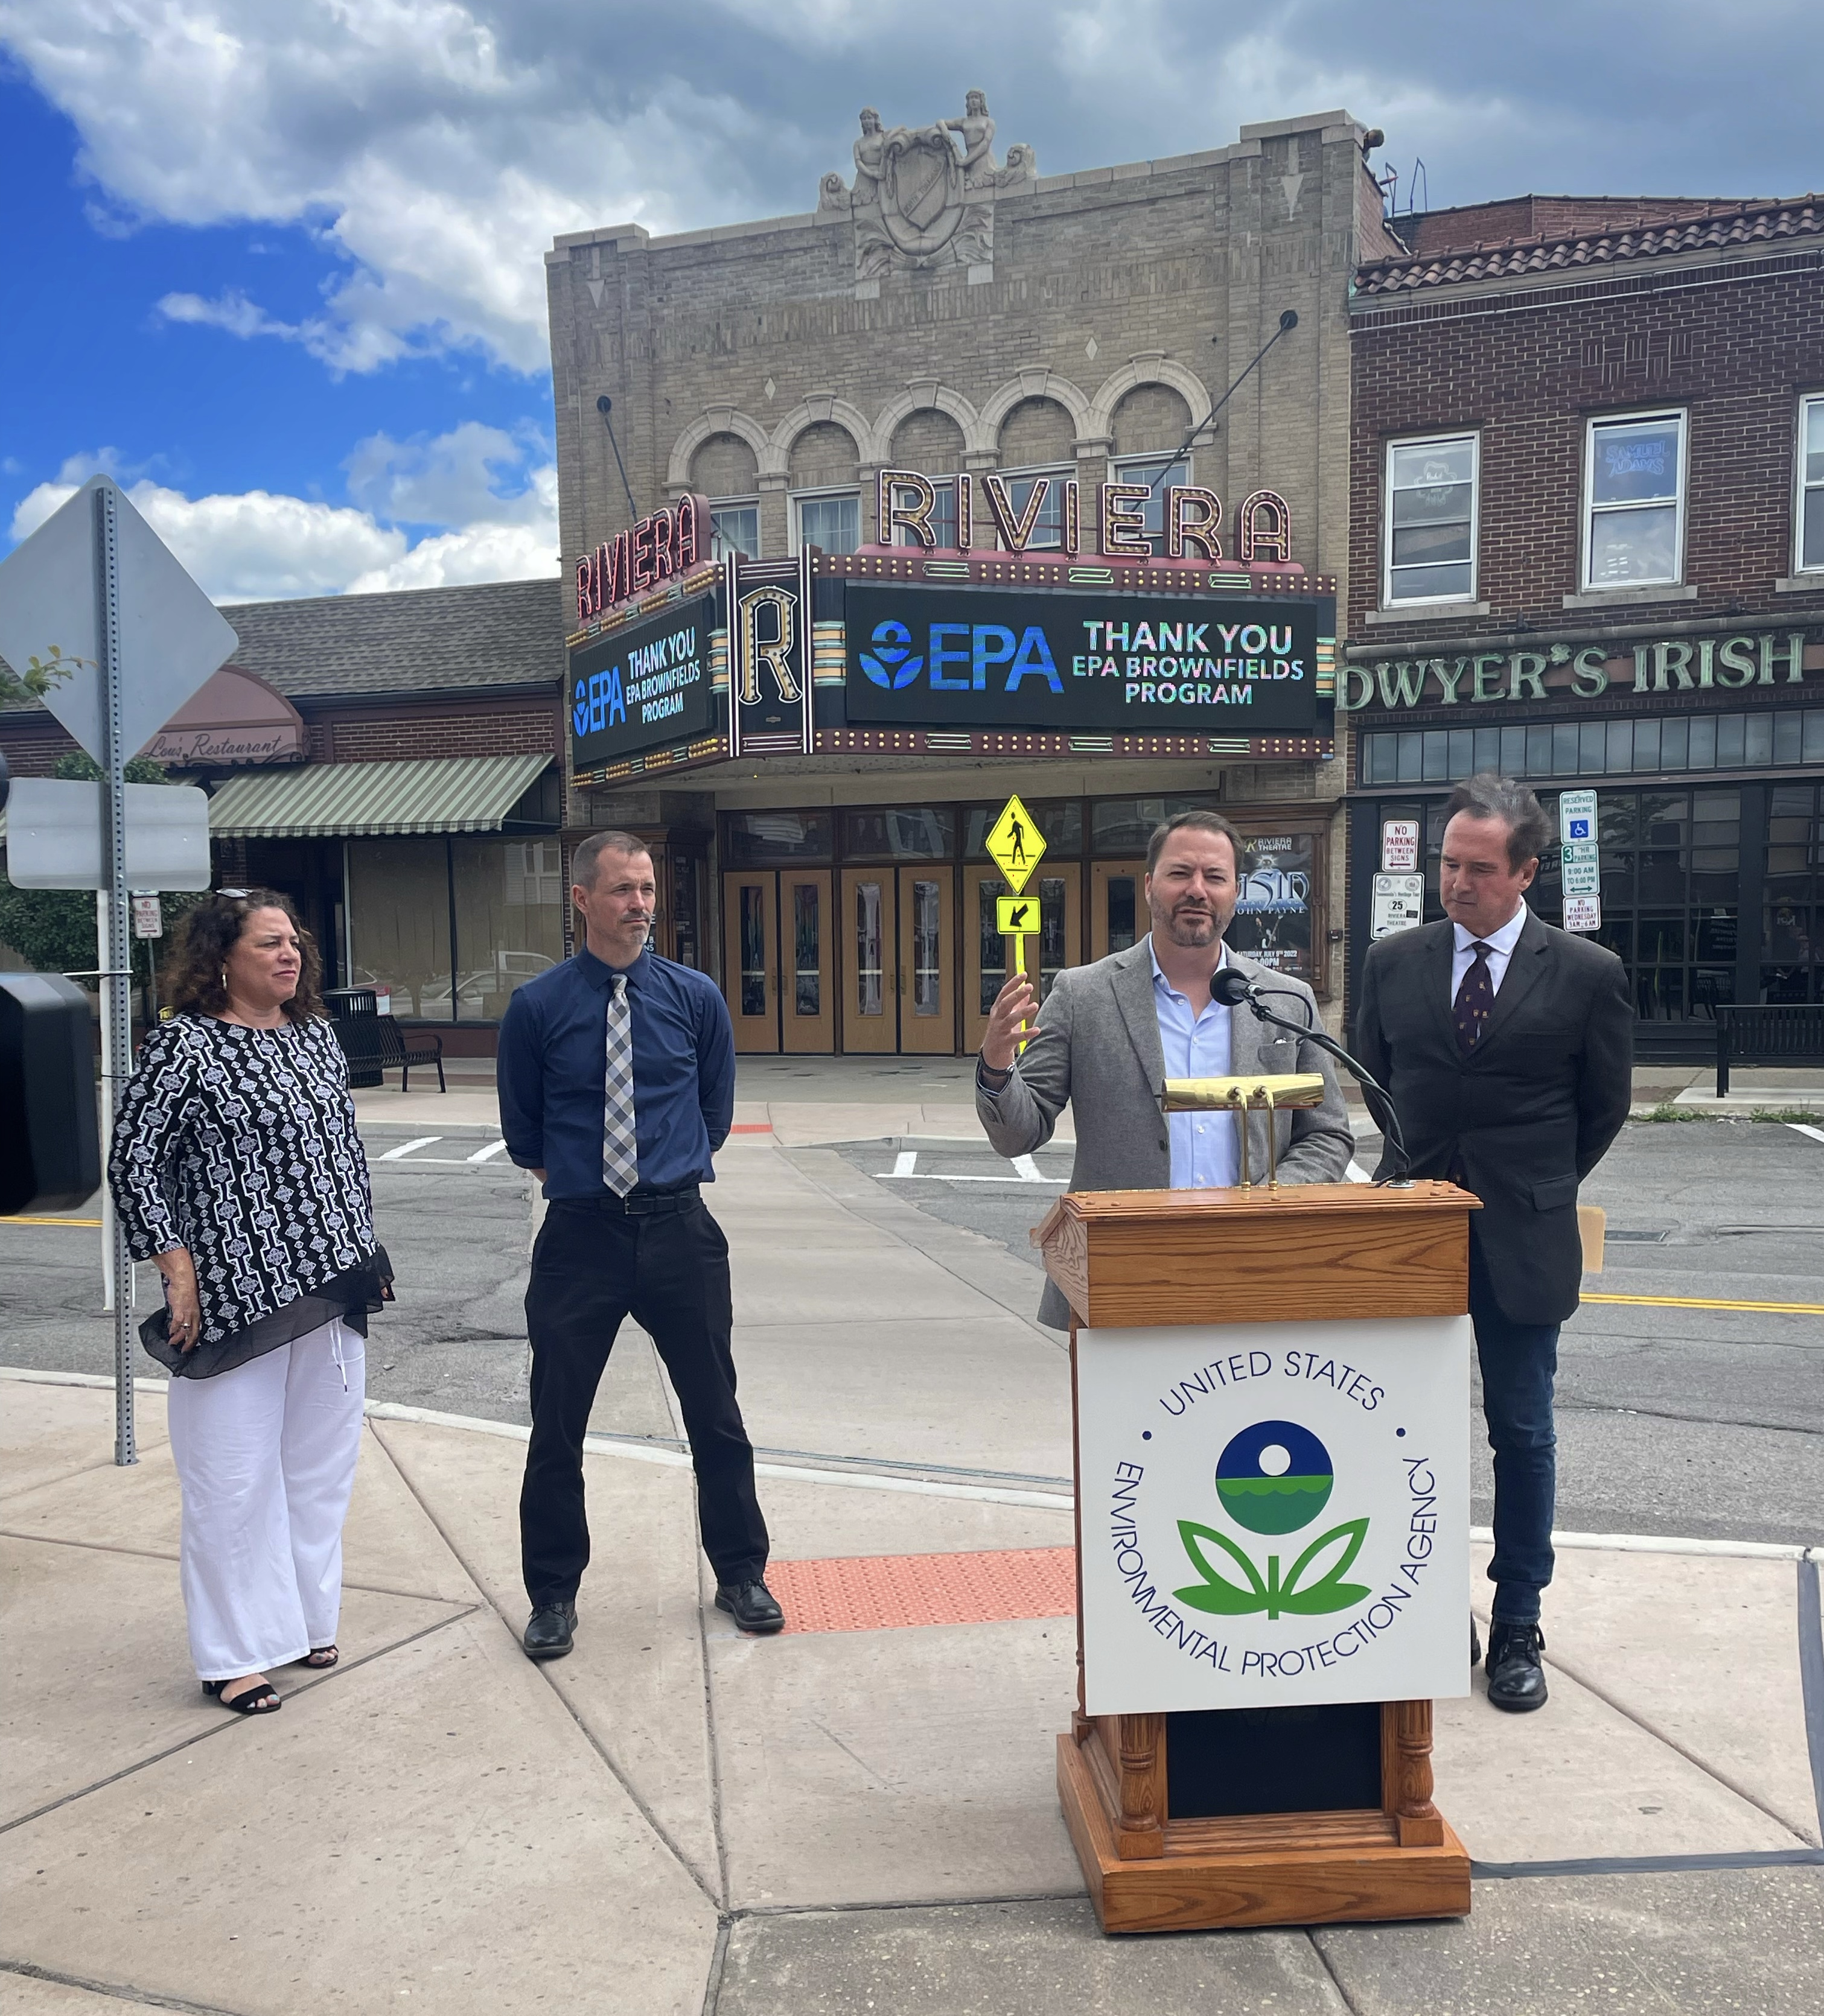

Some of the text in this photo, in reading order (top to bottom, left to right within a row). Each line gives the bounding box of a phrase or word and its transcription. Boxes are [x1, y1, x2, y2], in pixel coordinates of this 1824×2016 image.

[878, 468, 1291, 562] RIVIERA
[576, 492, 699, 618] RIVIERA
[628, 626, 695, 680] THANK YOU
[738, 585, 803, 705] R
[1083, 620, 1292, 655] THANK YOU
[929, 622, 1065, 694] EPA
[1072, 655, 1304, 680] EPA BROWNFIELDS
[1632, 633, 1806, 693] IRISH
[626, 659, 701, 705] EPA BROWNFIELDS
[1125, 682, 1252, 704] PROGRAM
[588, 665, 627, 734] EPA
[642, 692, 684, 724] PROGRAM
[190, 733, 282, 756] Restaurant
[1563, 795, 1593, 804] RESERVED
[1565, 806, 1592, 814] PARKING
[1258, 837, 1292, 845] RIVIERA
[1386, 836, 1415, 846] PARKING
[1395, 826, 1408, 835] NO
[1564, 847, 1572, 861] 3
[1392, 900, 1403, 910] 25
[1567, 912, 1596, 921] WEDNESDAY
[1159, 1350, 1385, 1416] UNITED STATES
[1110, 1457, 1438, 1677] ENVIRONMENTAL PROTECTION AGENCY
